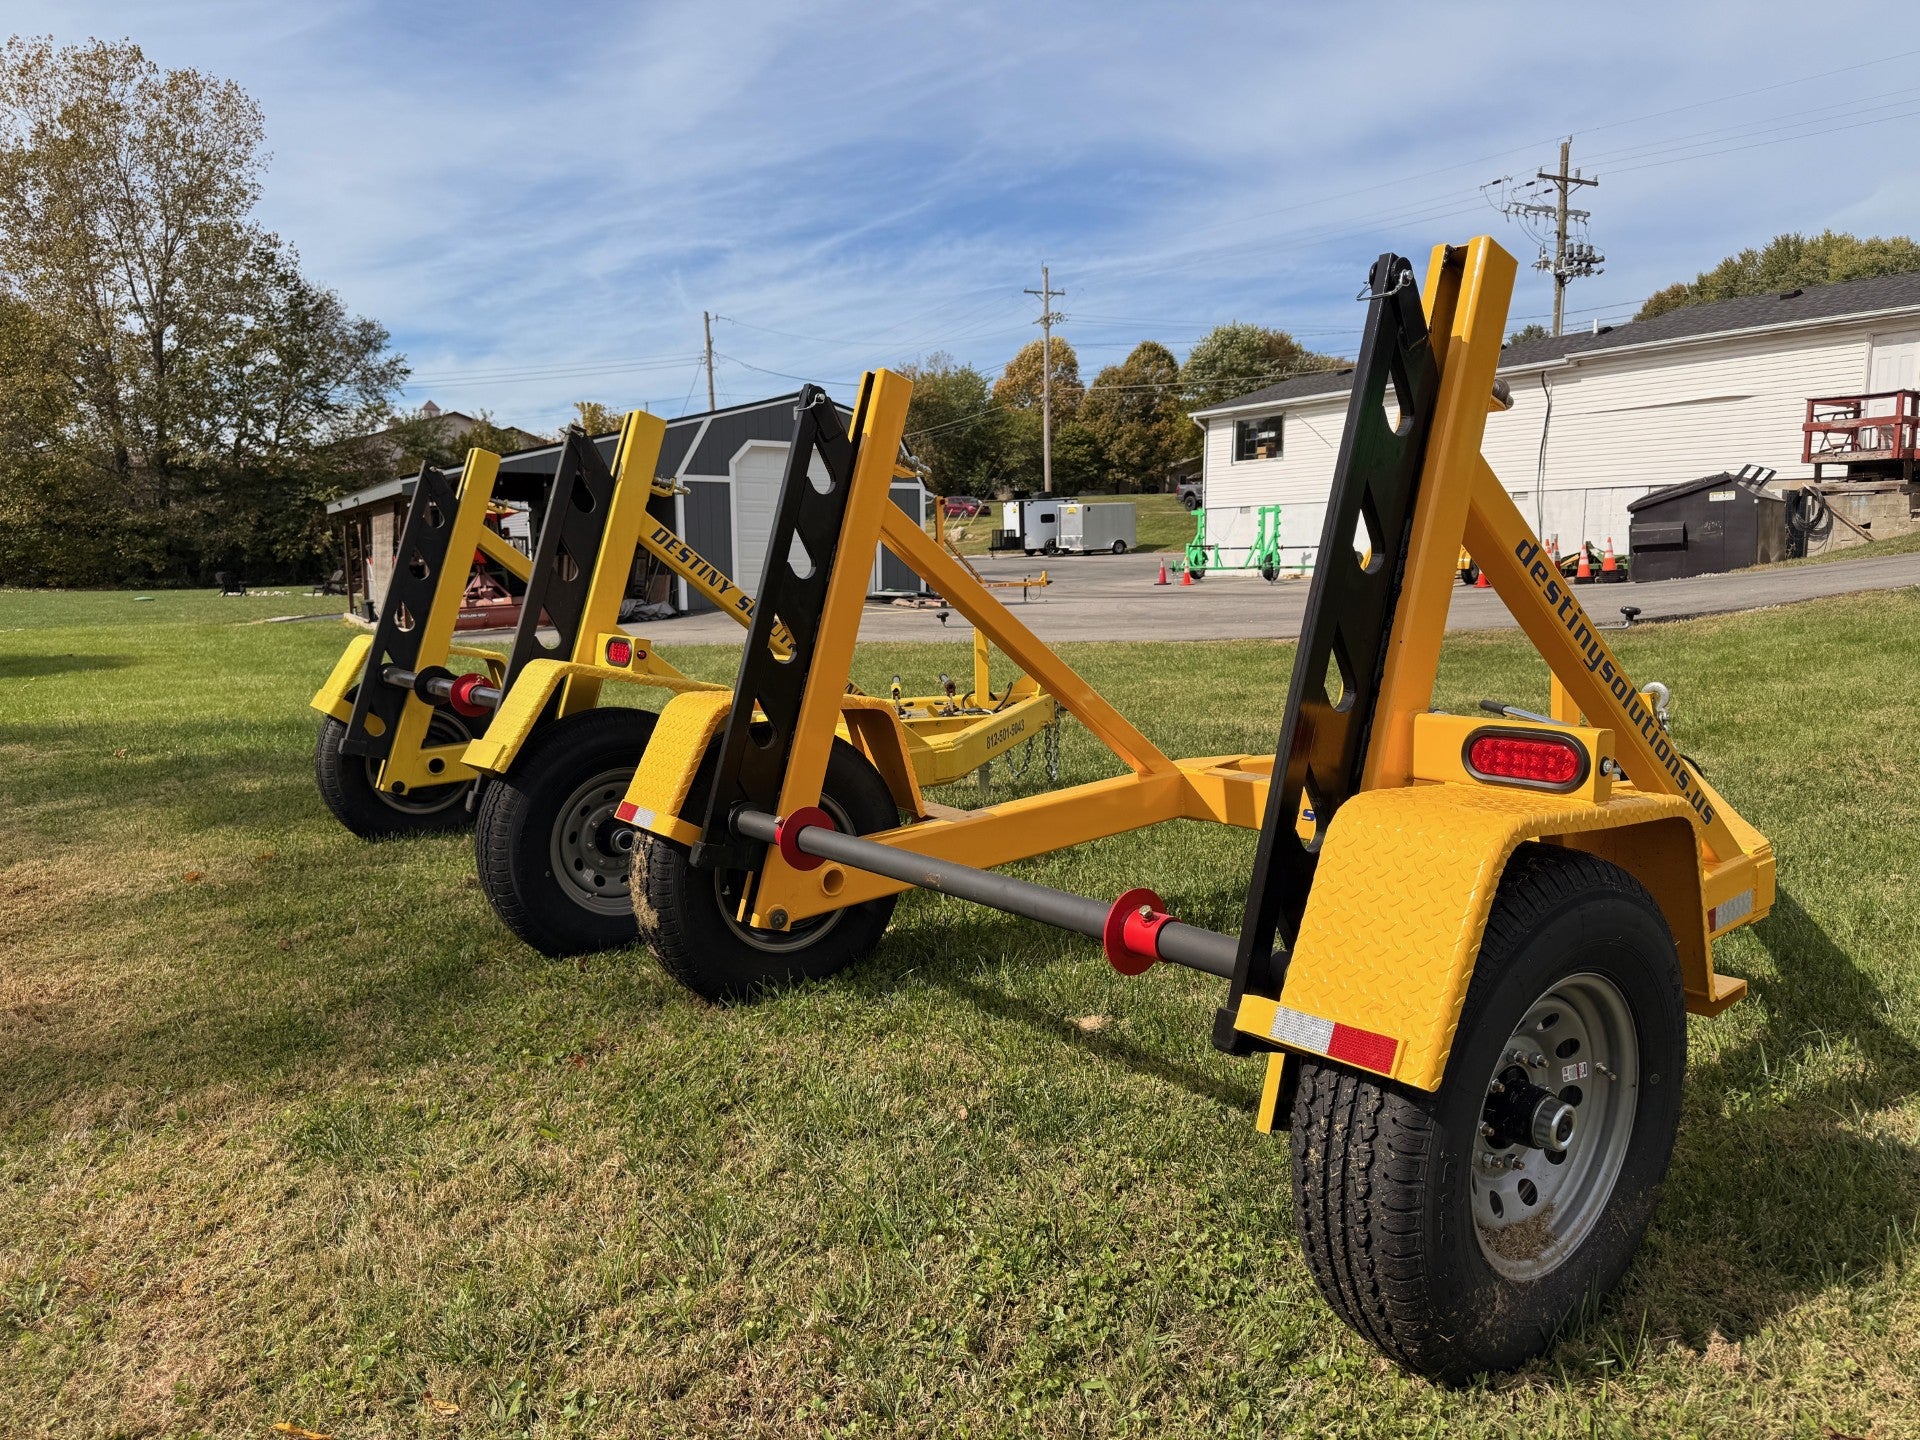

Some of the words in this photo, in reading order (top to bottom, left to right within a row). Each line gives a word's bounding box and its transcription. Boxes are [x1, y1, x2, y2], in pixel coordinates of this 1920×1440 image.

[651, 527, 734, 594] DESTINY
[1515, 538, 1715, 826] destinysolutions.us
[986, 718, 1025, 750] 812-501-5043
